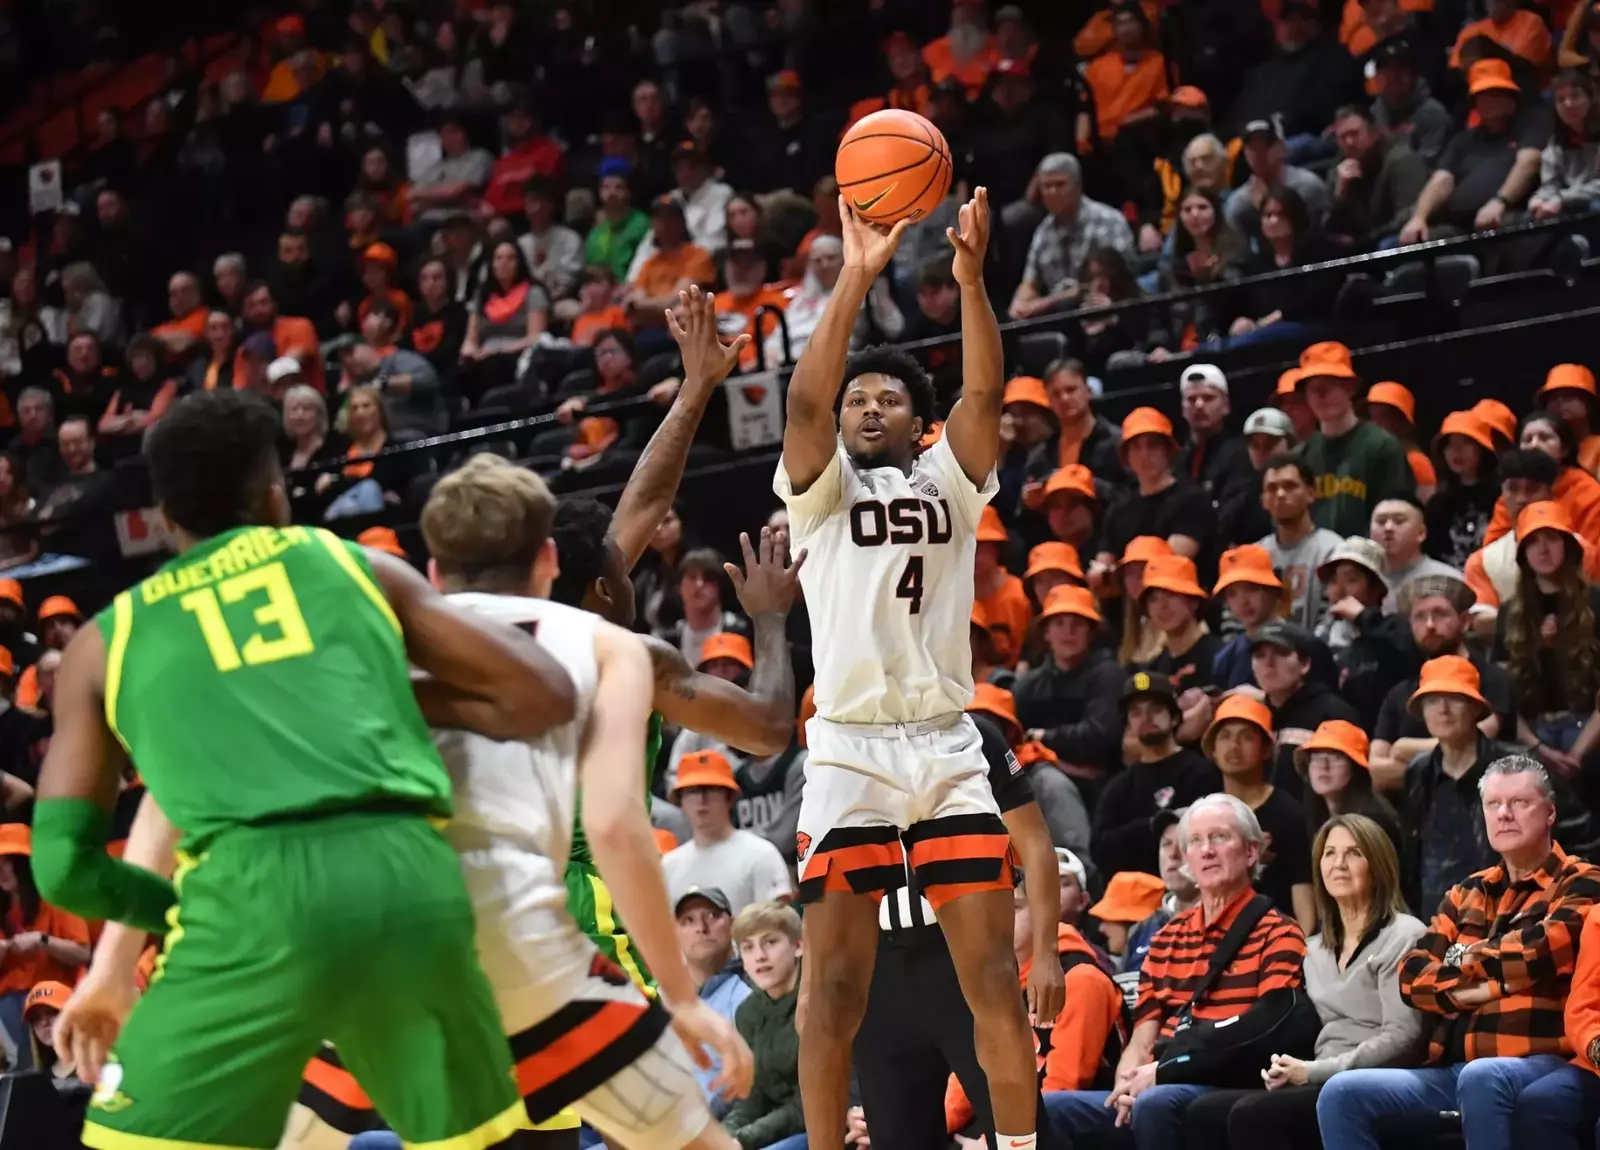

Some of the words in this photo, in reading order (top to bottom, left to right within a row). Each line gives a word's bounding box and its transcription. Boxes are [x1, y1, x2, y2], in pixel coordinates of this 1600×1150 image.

[849, 498, 953, 548] OSU
[895, 555, 924, 615] 4
[180, 561, 316, 672] 13
